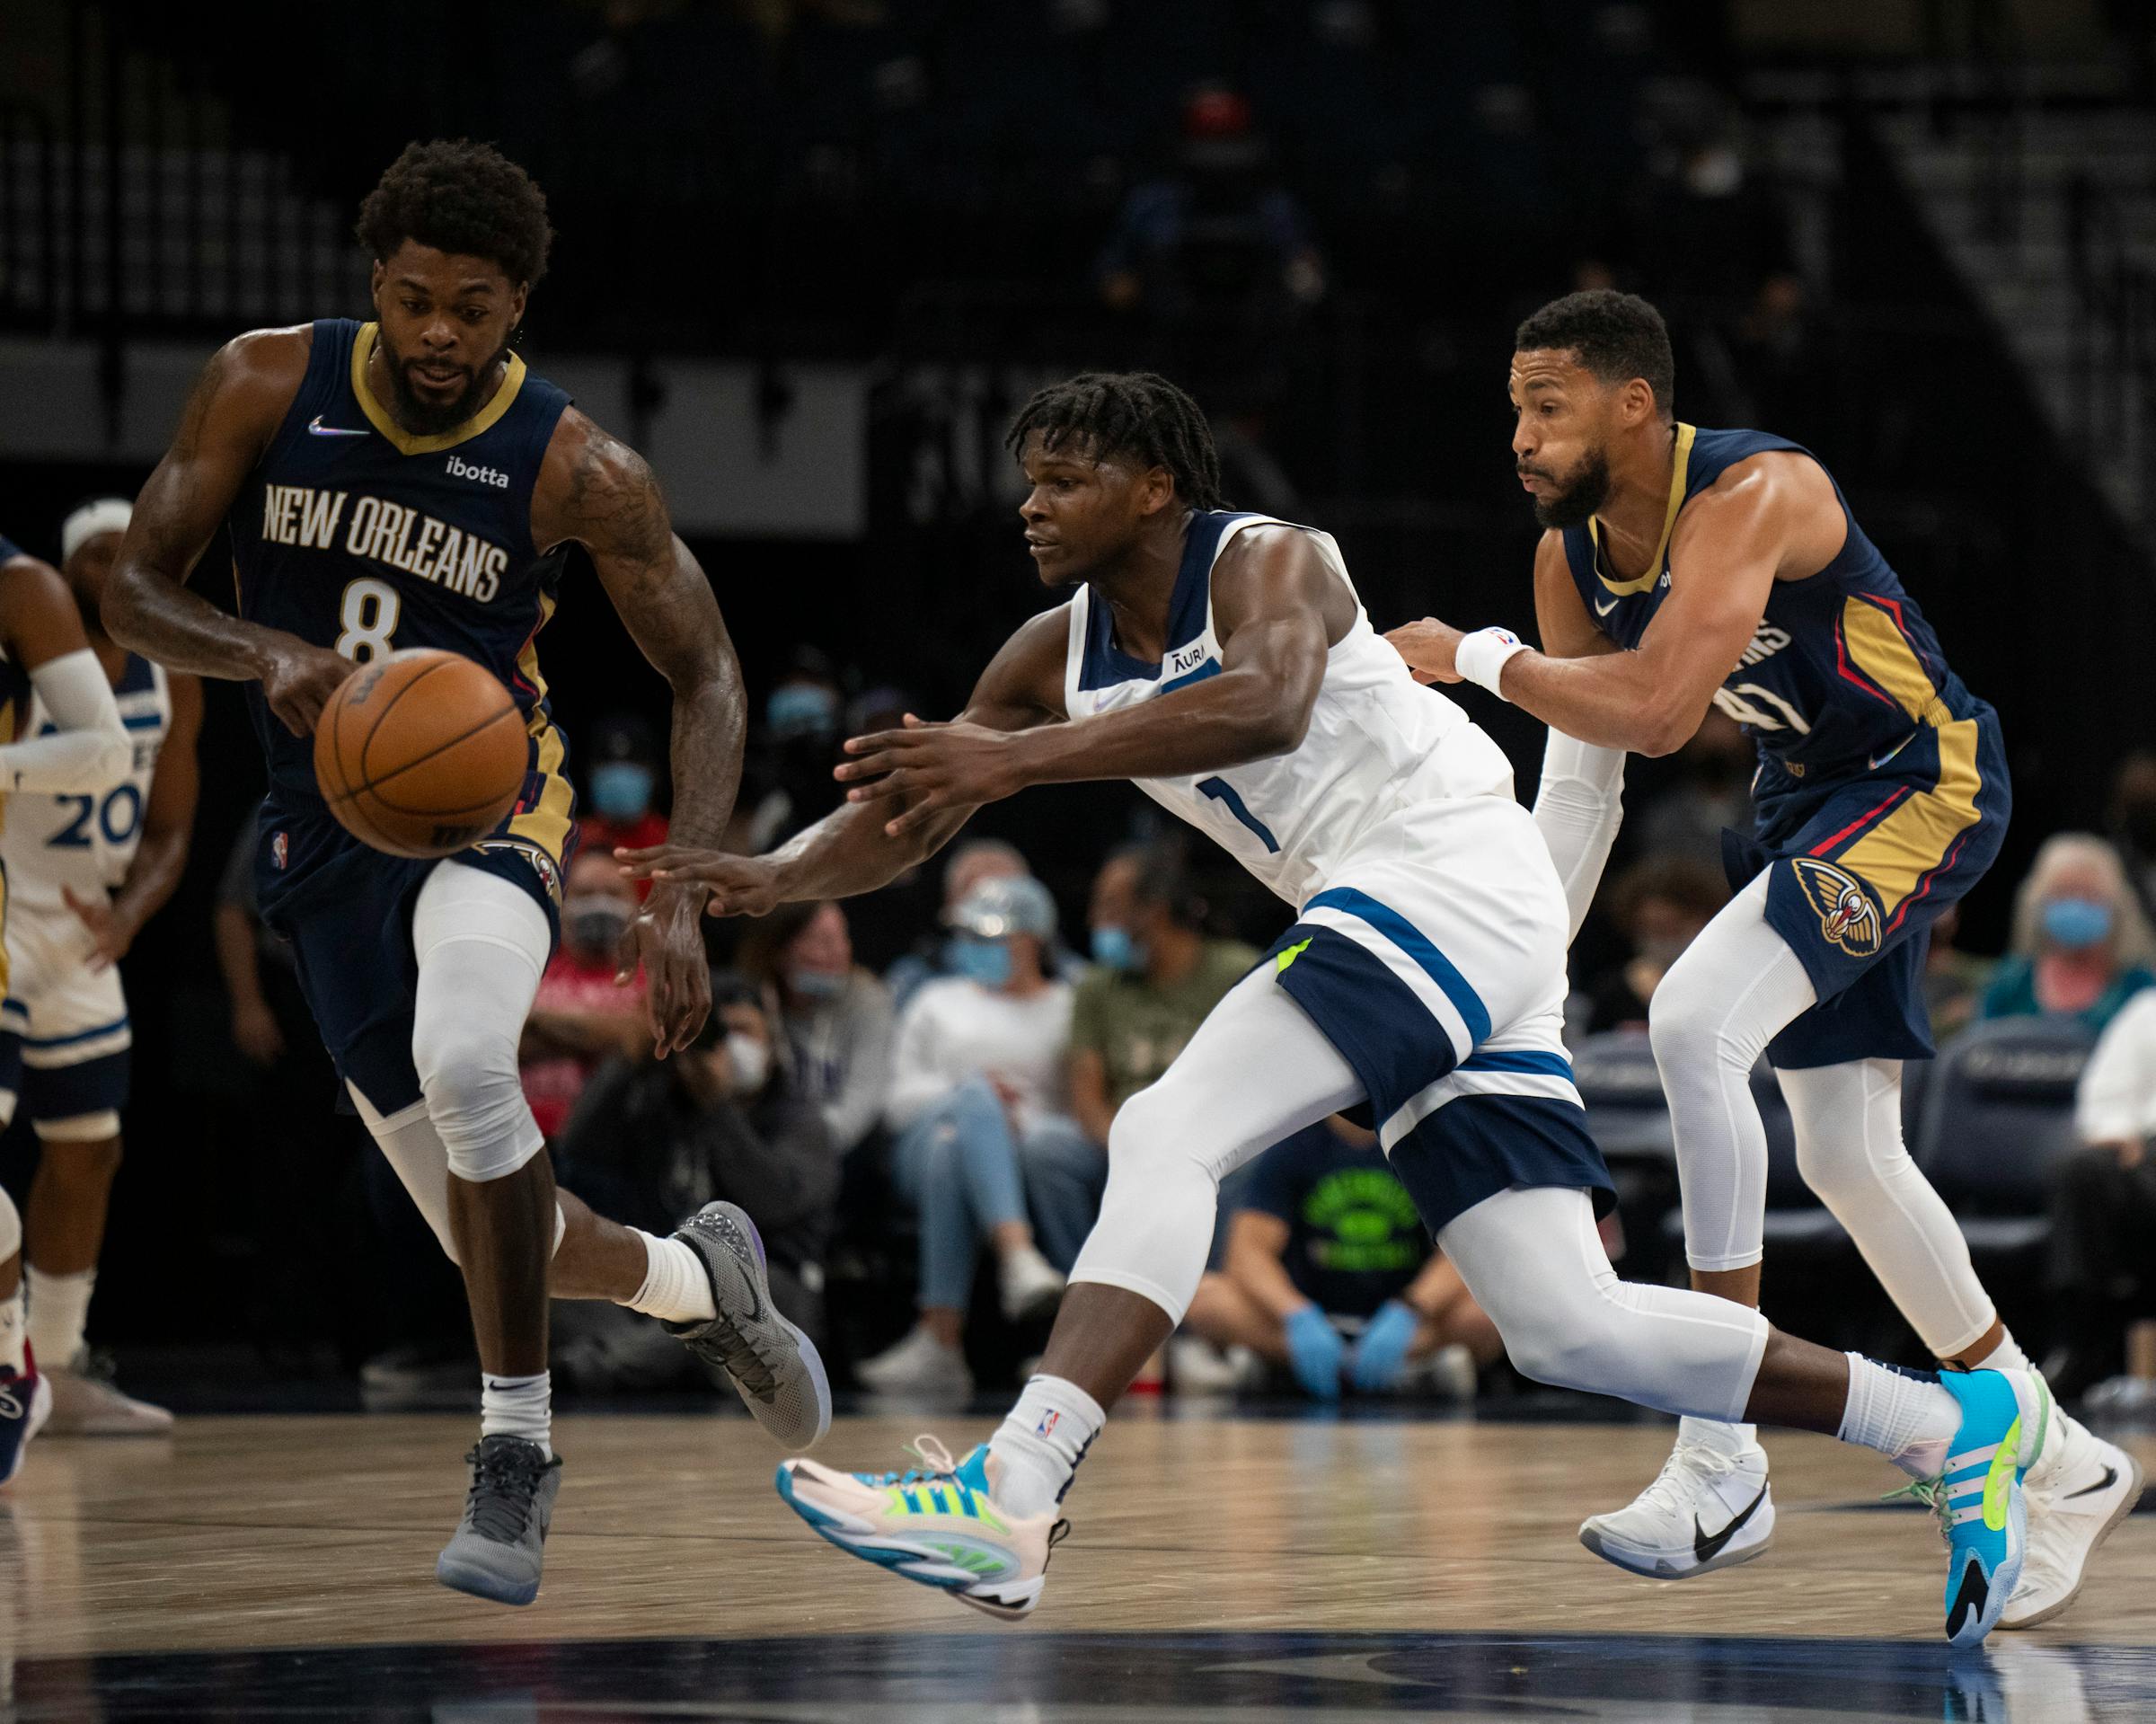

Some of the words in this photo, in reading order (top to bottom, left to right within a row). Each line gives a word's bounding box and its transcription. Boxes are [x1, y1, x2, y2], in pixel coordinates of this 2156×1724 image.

[446, 455, 509, 489] ibotta
[261, 483, 349, 550] NEW
[345, 495, 509, 604] ORLEANS
[333, 577, 402, 665] 8
[48, 783, 141, 847] 20
[1195, 776, 1282, 854] 1
